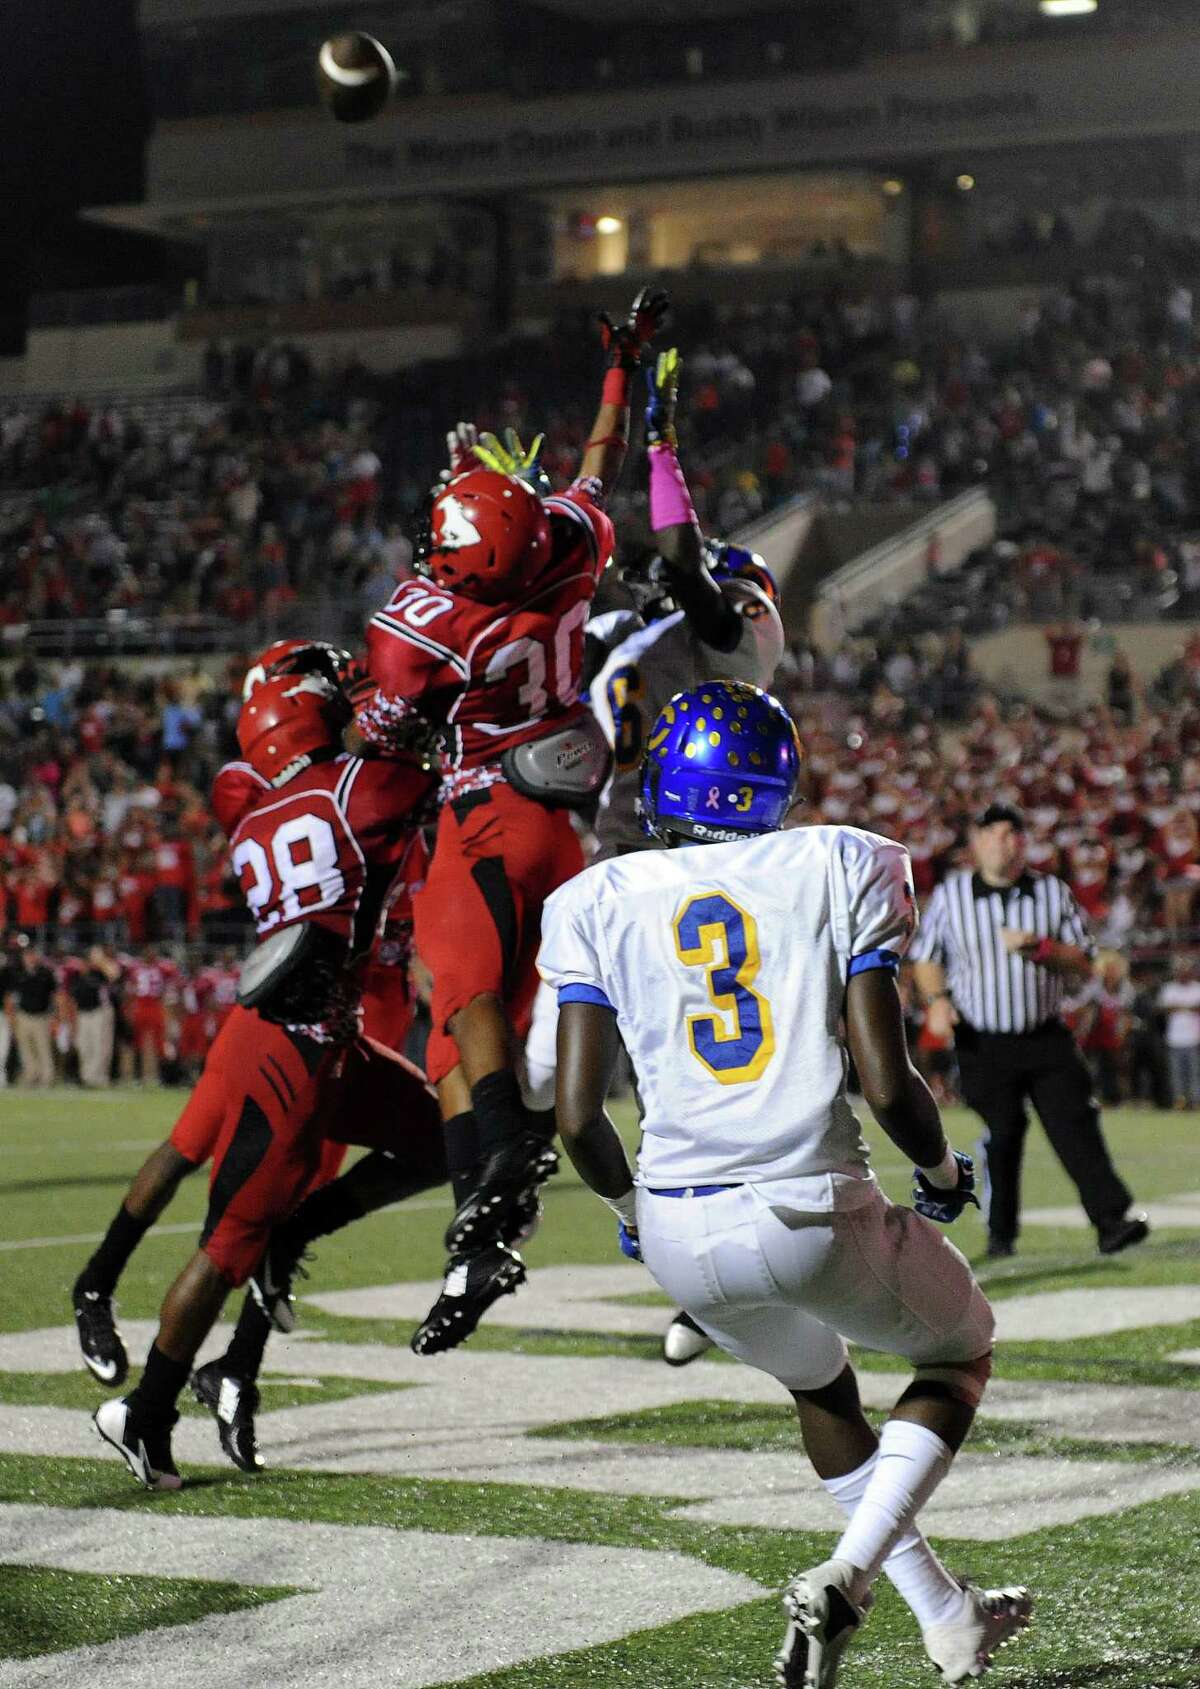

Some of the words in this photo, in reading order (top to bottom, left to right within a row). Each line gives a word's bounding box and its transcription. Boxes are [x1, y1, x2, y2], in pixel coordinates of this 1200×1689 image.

[735, 786, 753, 812] 3
[231, 812, 346, 934] 28
[672, 889, 776, 1086] 3
